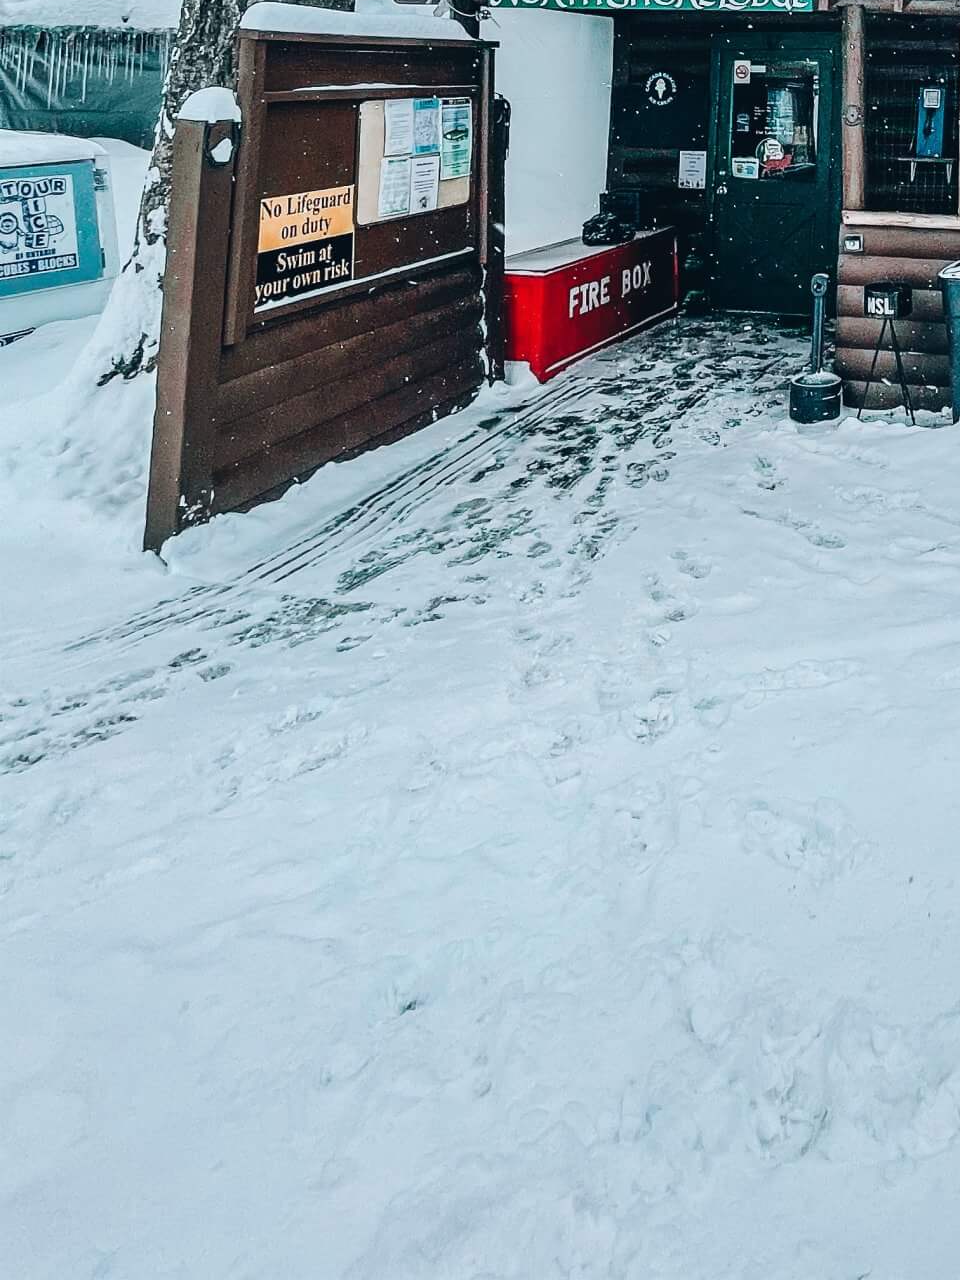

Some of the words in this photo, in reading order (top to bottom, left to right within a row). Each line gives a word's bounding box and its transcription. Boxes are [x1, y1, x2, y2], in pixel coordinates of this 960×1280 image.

[261, 200, 282, 220] No
[286, 187, 351, 216] Lifeguard
[281, 224, 297, 240] on
[301, 216, 332, 236] duty
[38, 255, 76, 271] BLOCKS
[276, 248, 316, 273] Swim
[319, 243, 333, 263] at
[254, 277, 291, 305] your
[292, 269, 321, 289] own
[324, 258, 350, 281] risk
[568, 275, 611, 319] FIRE
[621, 261, 652, 298] BOX
[867, 296, 895, 315] NSL
